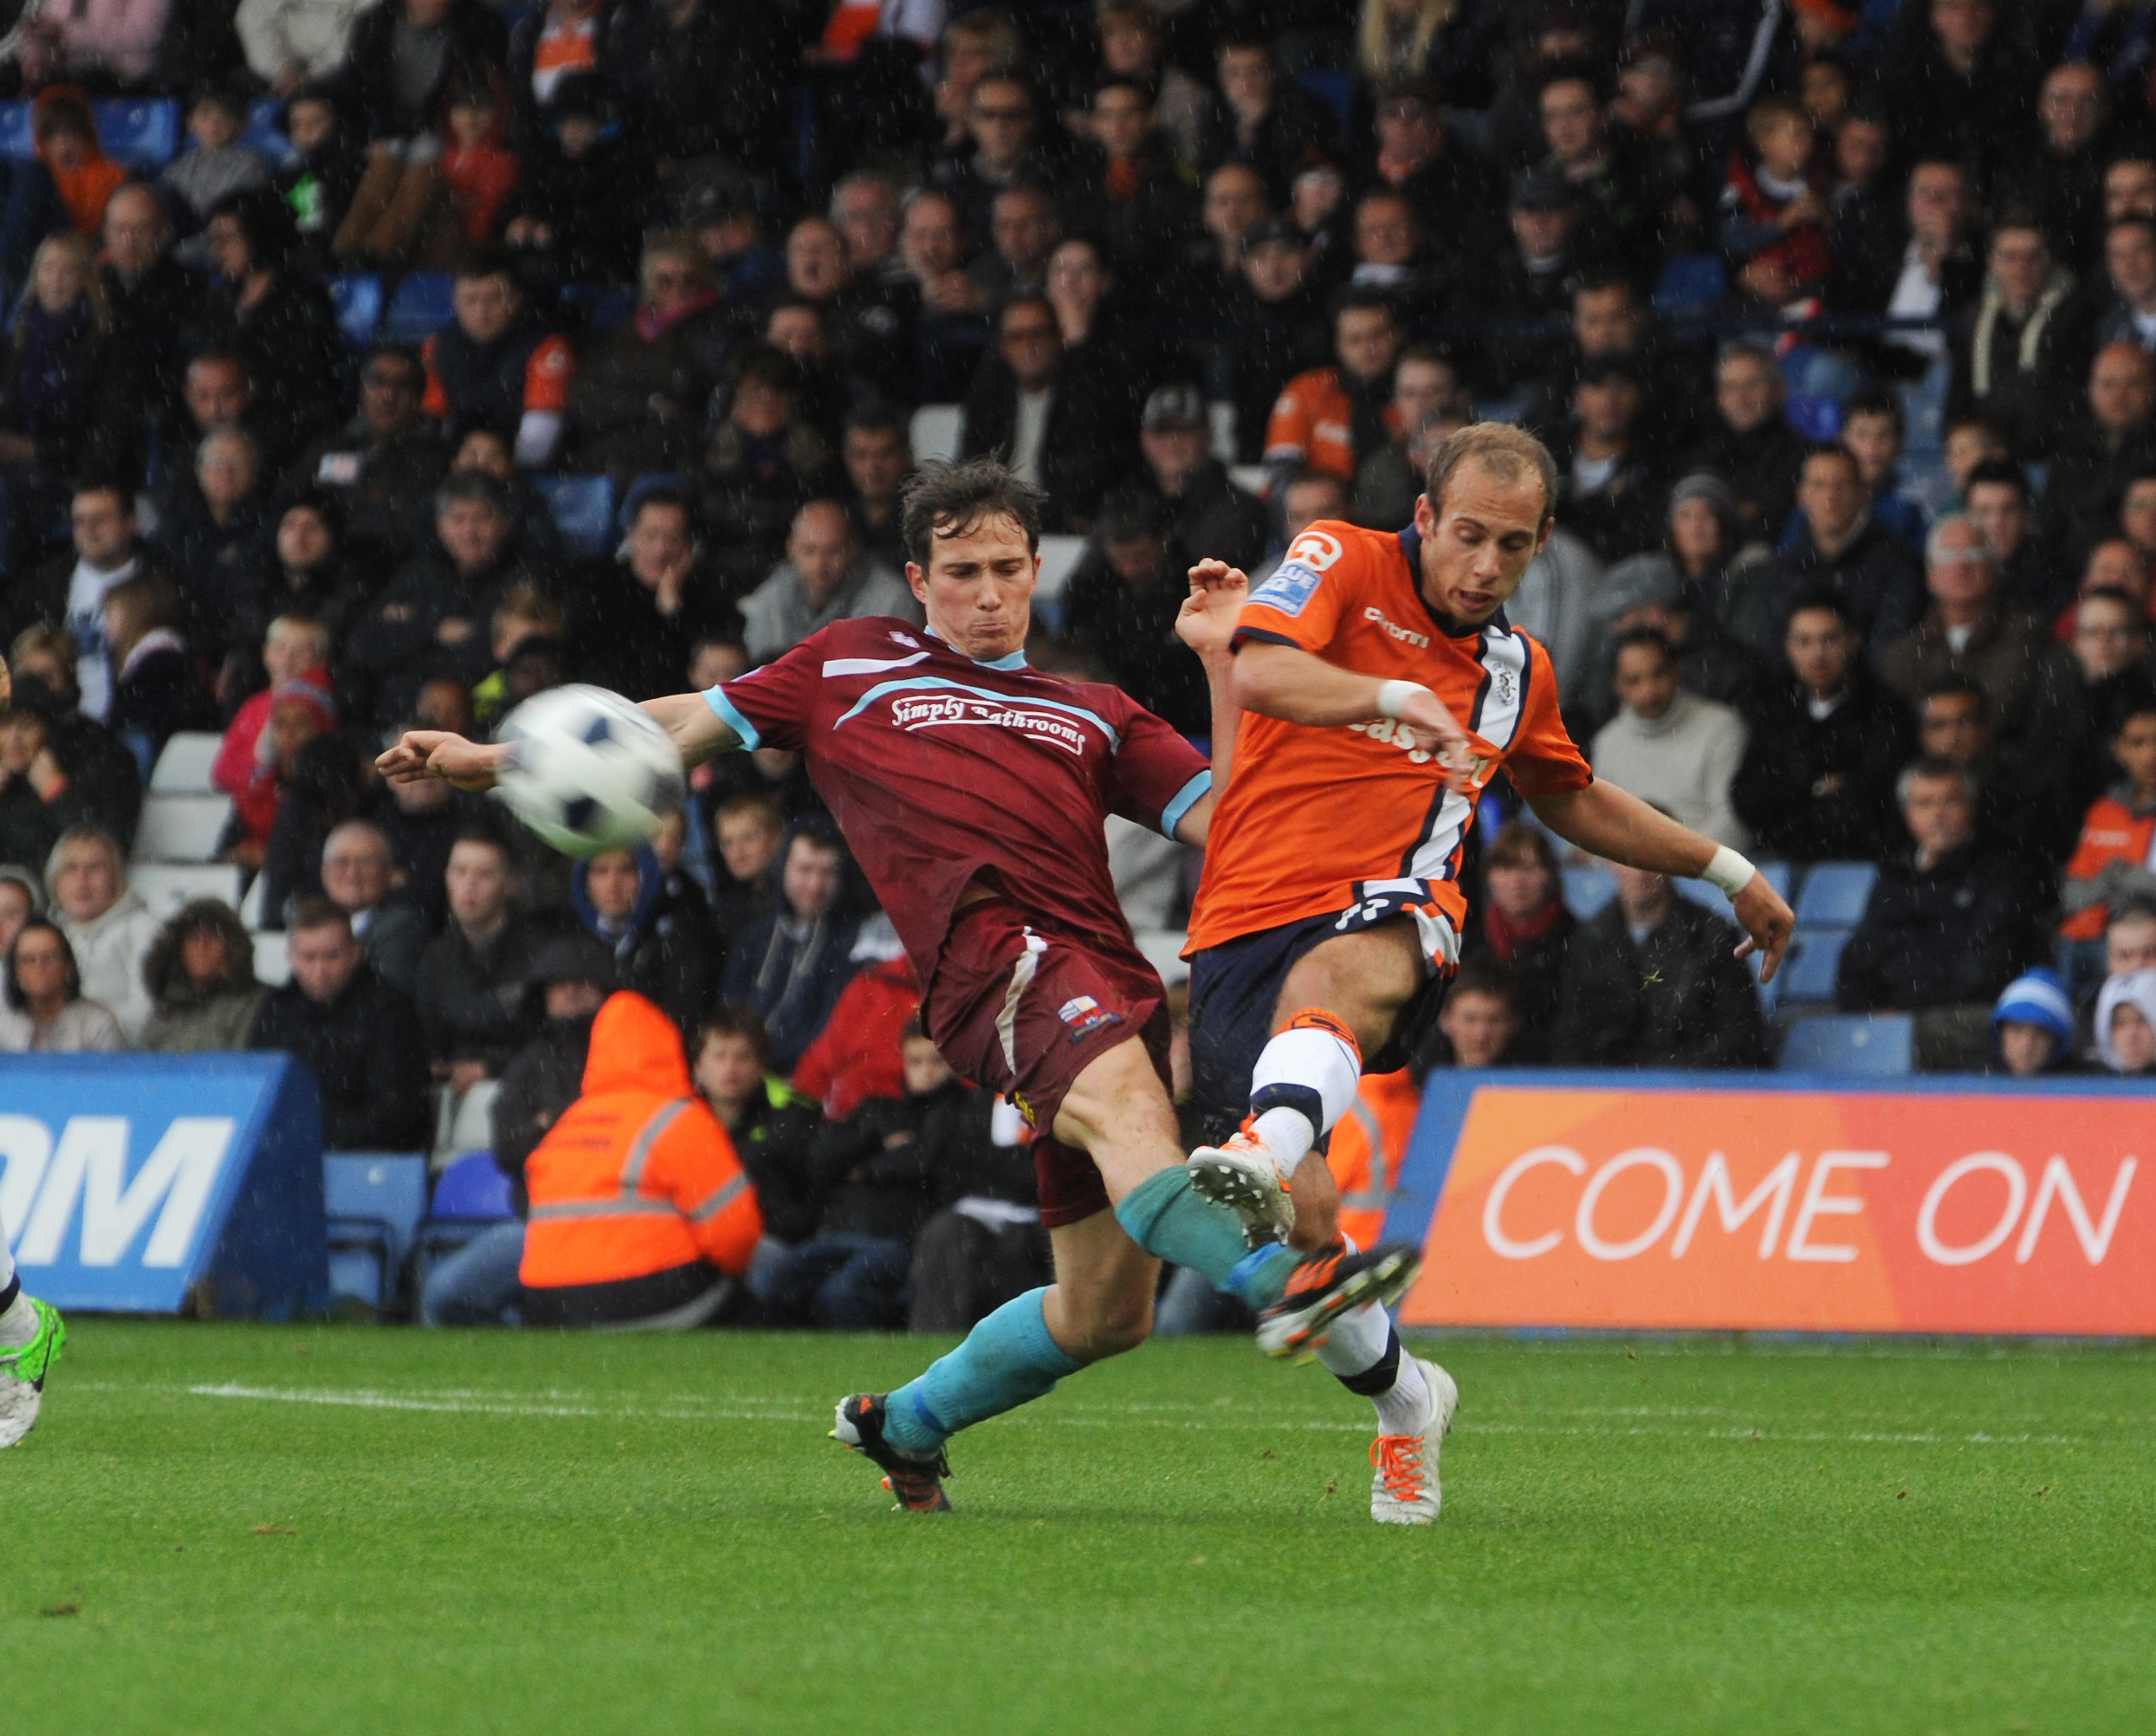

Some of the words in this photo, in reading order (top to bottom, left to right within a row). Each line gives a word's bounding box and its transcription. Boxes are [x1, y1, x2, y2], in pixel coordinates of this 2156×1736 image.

[891, 697, 966, 727] Simply
[1482, 1144, 1891, 1262] COME
[1915, 1150, 2139, 1267] ON
